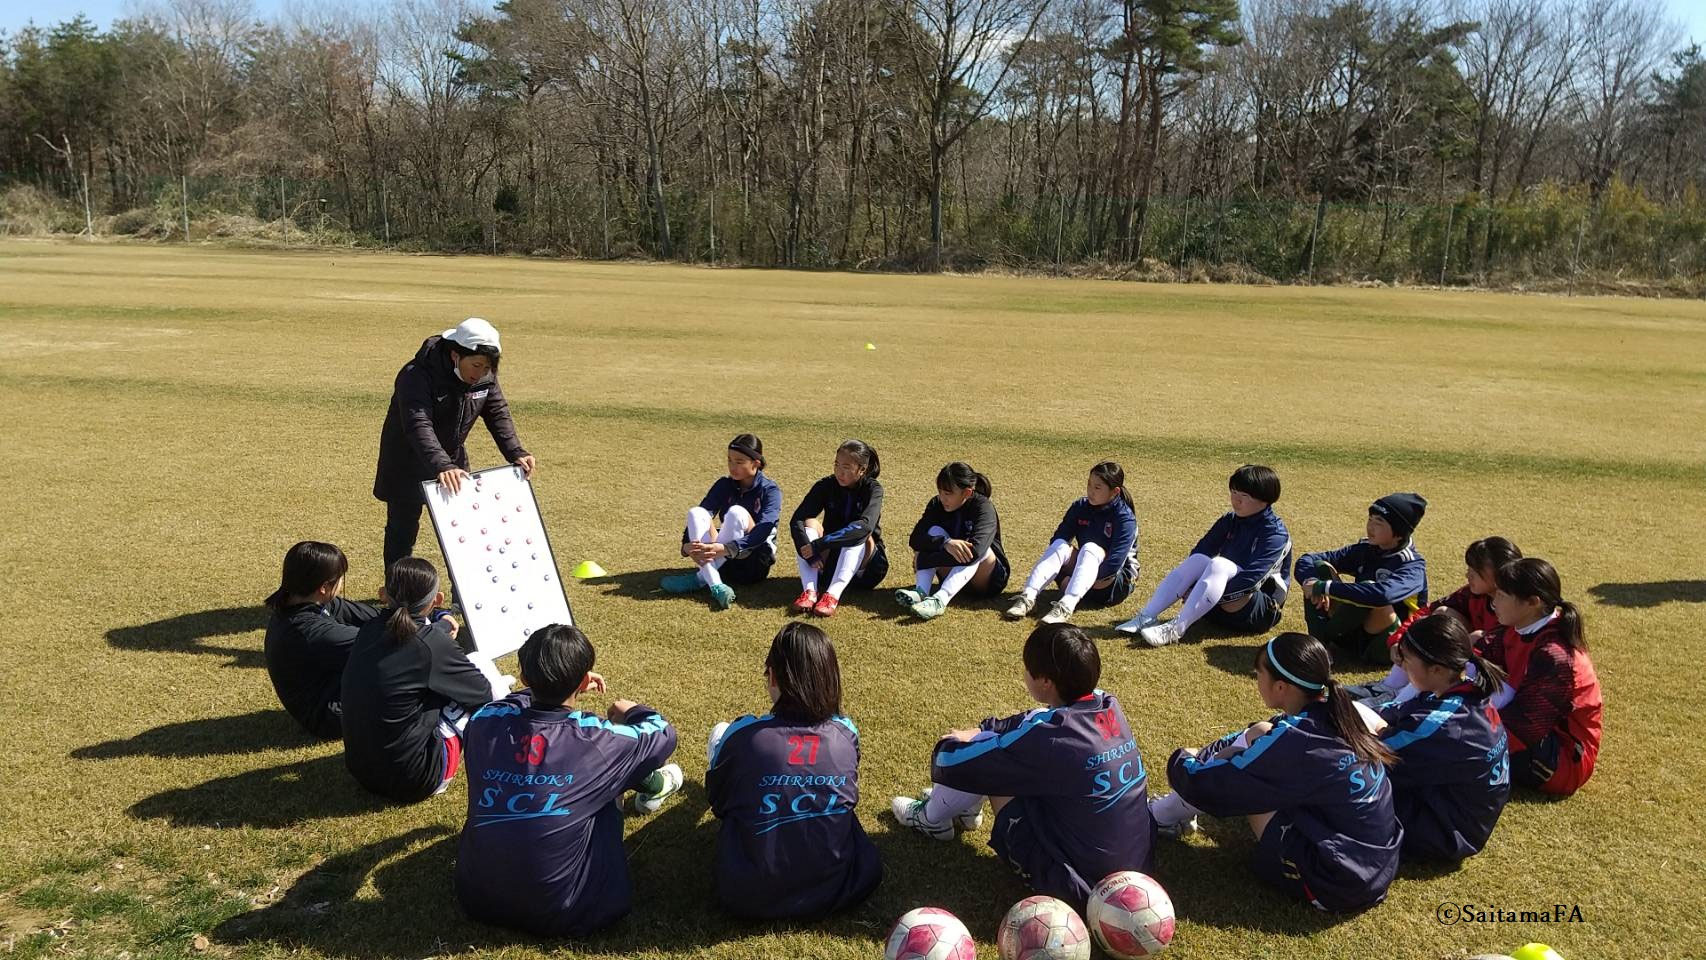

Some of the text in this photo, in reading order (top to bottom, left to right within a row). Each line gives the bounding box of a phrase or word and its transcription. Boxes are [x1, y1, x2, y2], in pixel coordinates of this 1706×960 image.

[514, 734, 547, 766] 33
[787, 735, 821, 766] 27
[482, 768, 575, 787] SHIRAOKA
[758, 774, 848, 787] SHIRAOKA
